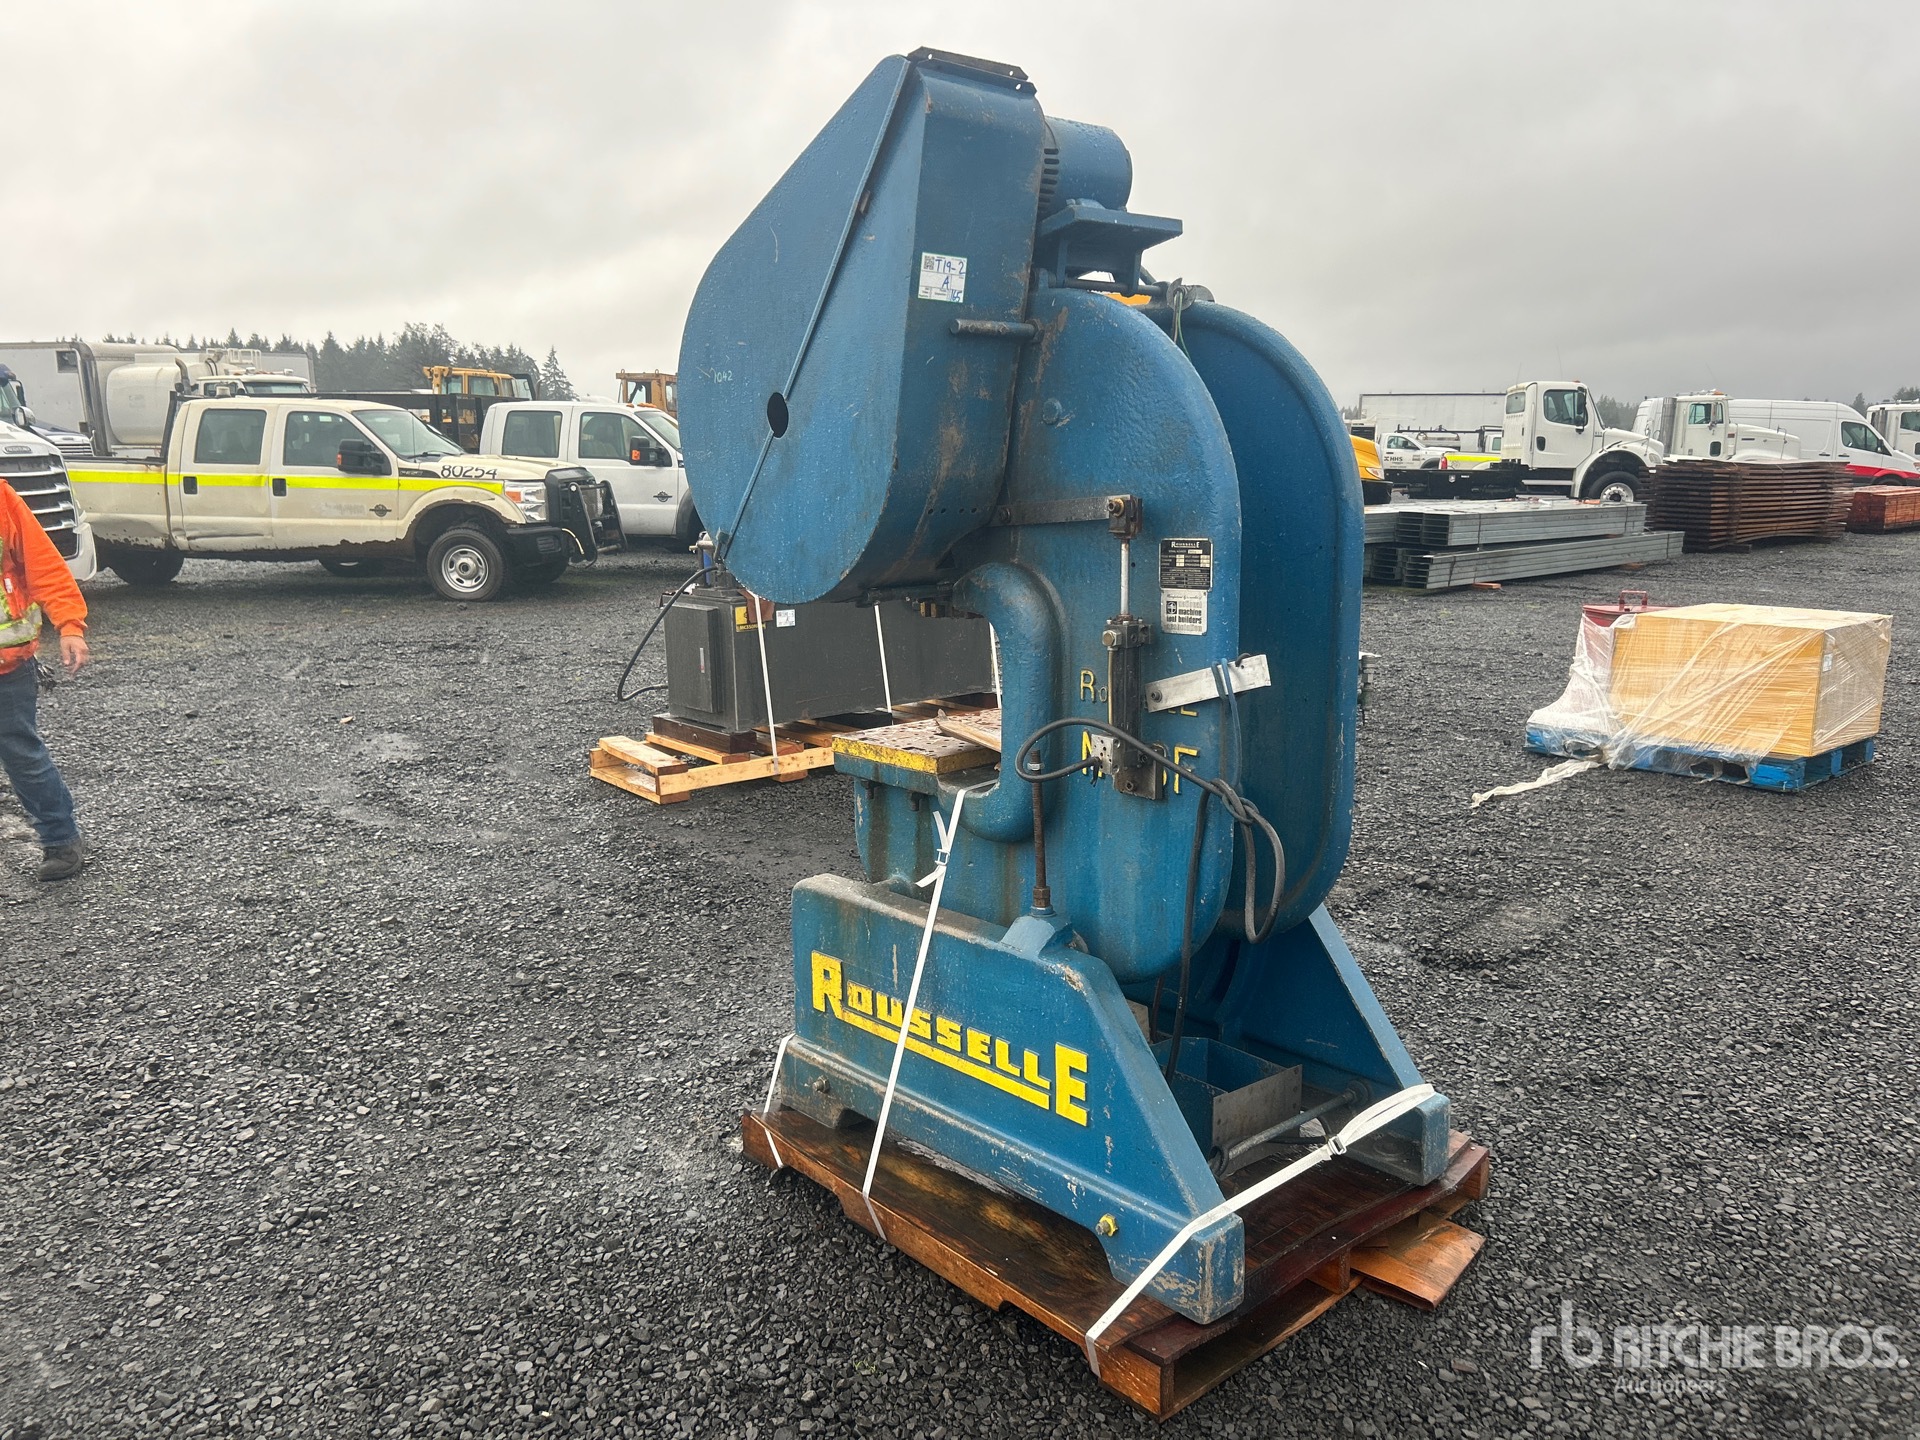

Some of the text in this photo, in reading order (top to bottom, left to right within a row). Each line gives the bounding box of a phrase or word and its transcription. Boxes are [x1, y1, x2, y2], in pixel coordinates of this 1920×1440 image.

[941, 276, 950, 290] A
[440, 464, 498, 480] 80254
[811, 949, 1088, 1127] ROUSSELLE
